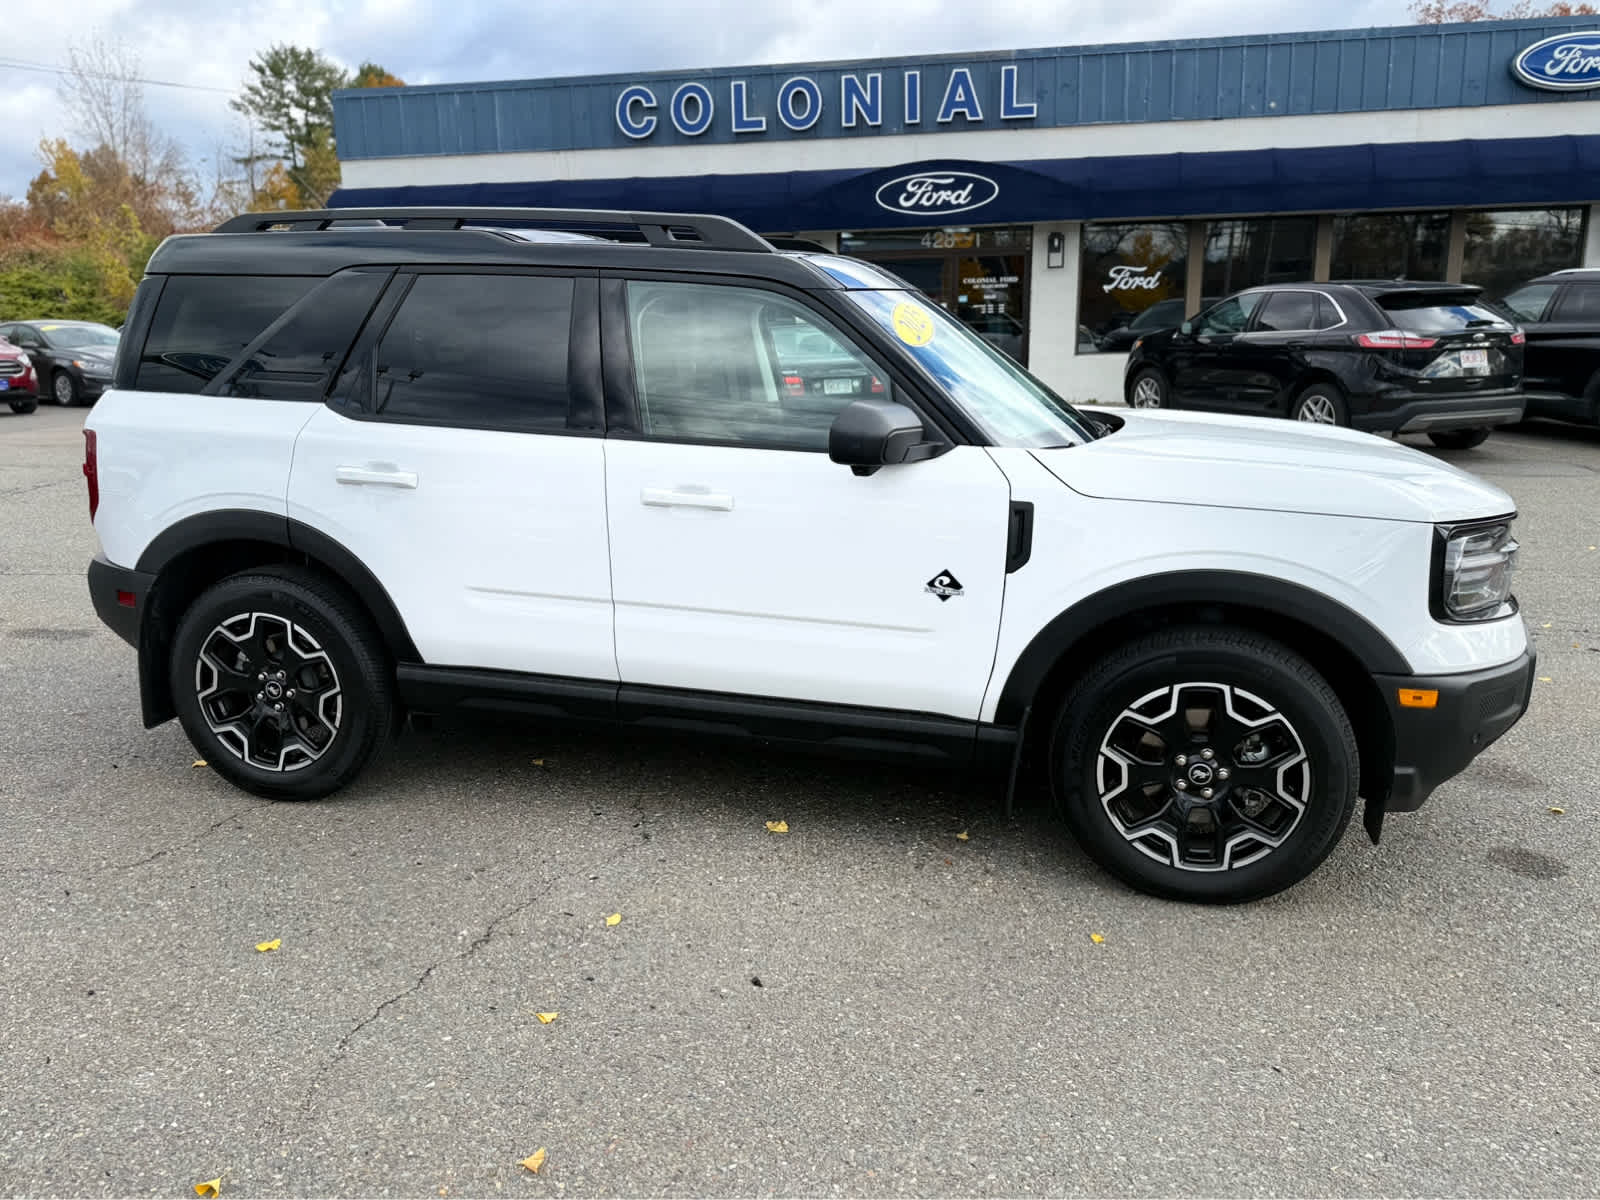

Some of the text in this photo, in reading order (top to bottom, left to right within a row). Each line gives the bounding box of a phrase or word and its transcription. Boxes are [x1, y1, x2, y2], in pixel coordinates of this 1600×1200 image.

[1545, 44, 1600, 75] For
[616, 66, 1037, 138] COLONIAL
[899, 177, 974, 207] Ford
[1103, 266, 1162, 293] Ford
